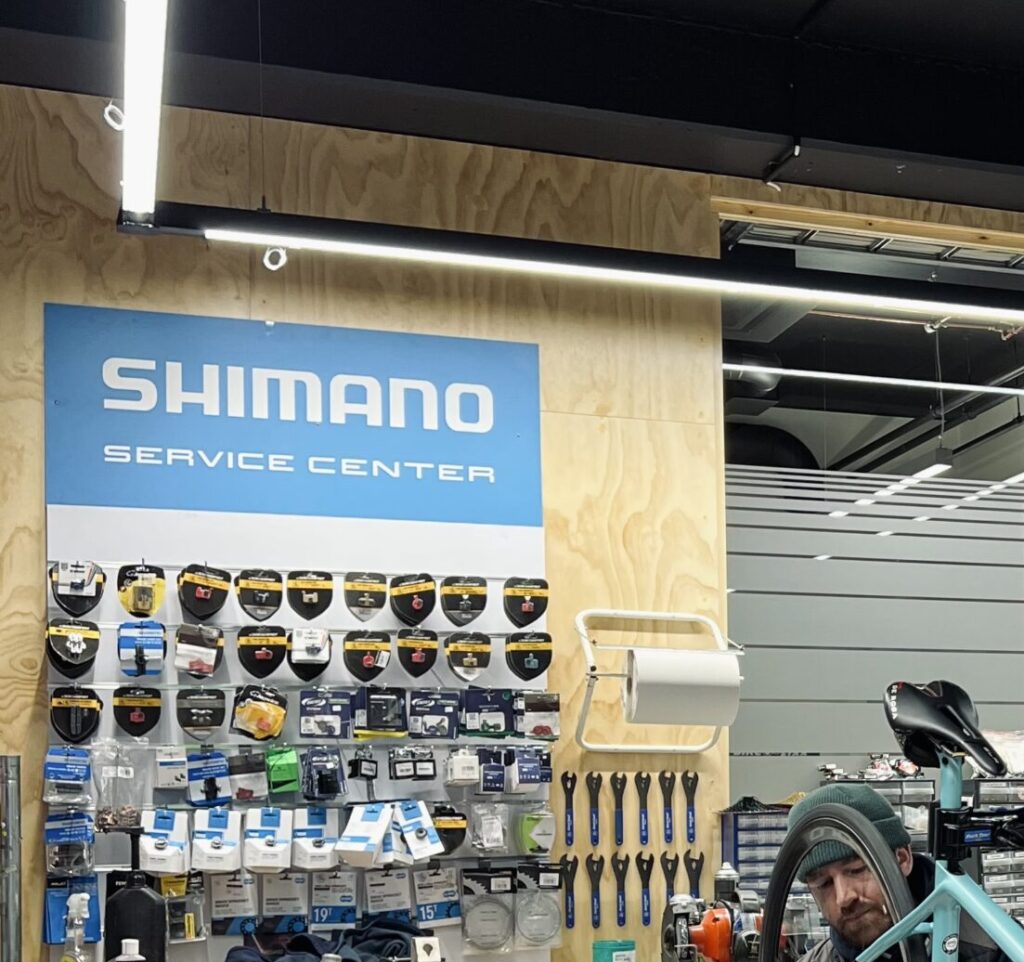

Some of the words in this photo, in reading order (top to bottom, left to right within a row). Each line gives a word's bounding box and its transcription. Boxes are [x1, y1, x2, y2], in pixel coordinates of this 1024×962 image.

[102, 356, 495, 434] SHIMANO
[103, 444, 295, 473] SERVICE
[308, 455, 496, 484] CENTER
